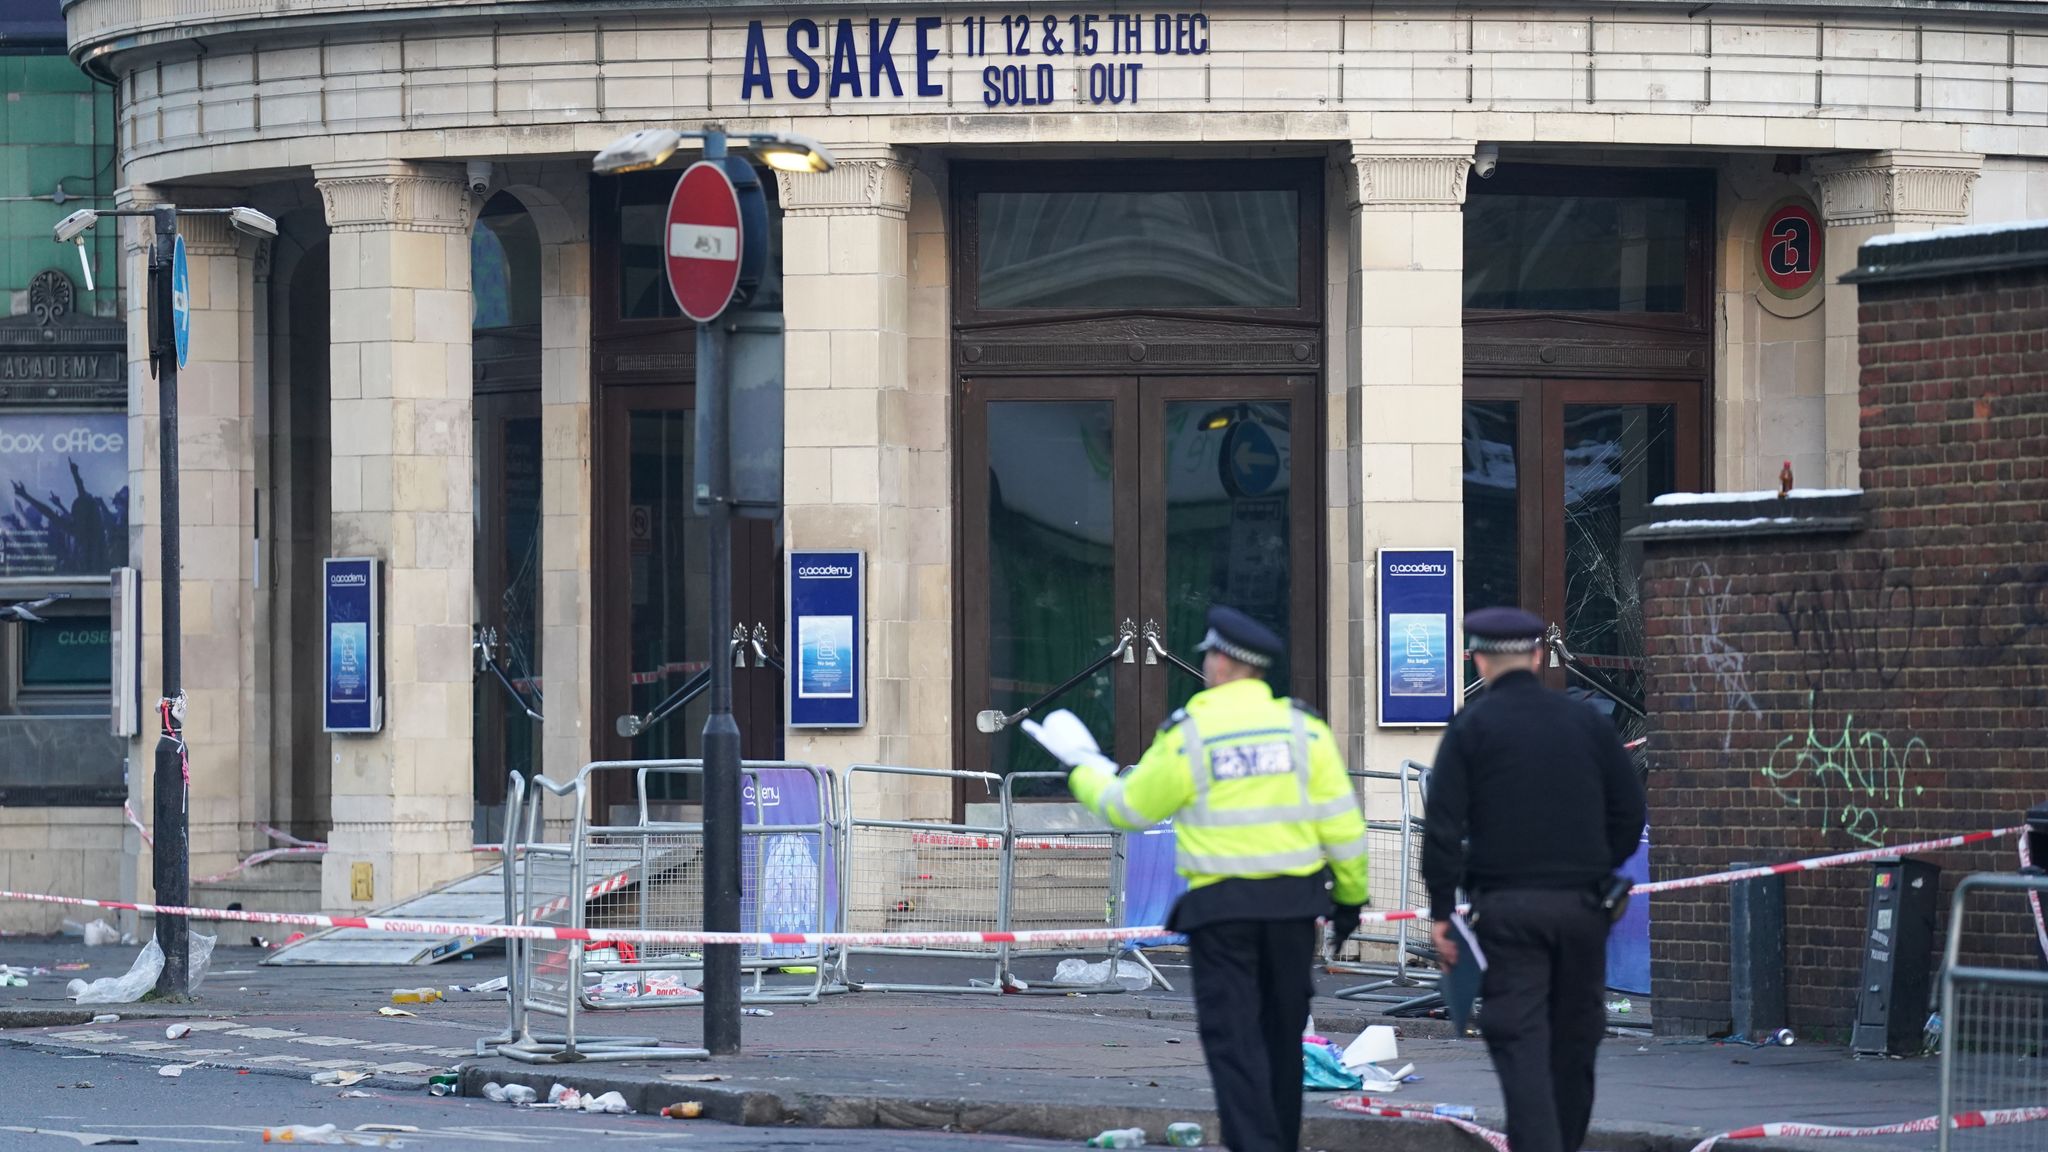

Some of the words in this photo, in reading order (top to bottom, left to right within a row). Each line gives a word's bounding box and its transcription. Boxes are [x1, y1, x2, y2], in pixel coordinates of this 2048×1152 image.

[1001, 15, 1031, 55] 12
[1042, 15, 1064, 55] &
[1154, 13, 1208, 55] DEC
[742, 17, 943, 99] ASAKE
[983, 64, 1054, 107] SOLD
[1090, 63, 1143, 104] OUT
[4, 356, 99, 378] ACADEMY
[0, 428, 45, 453] box
[52, 427, 124, 453] office
[58, 630, 112, 644] CLOSE
